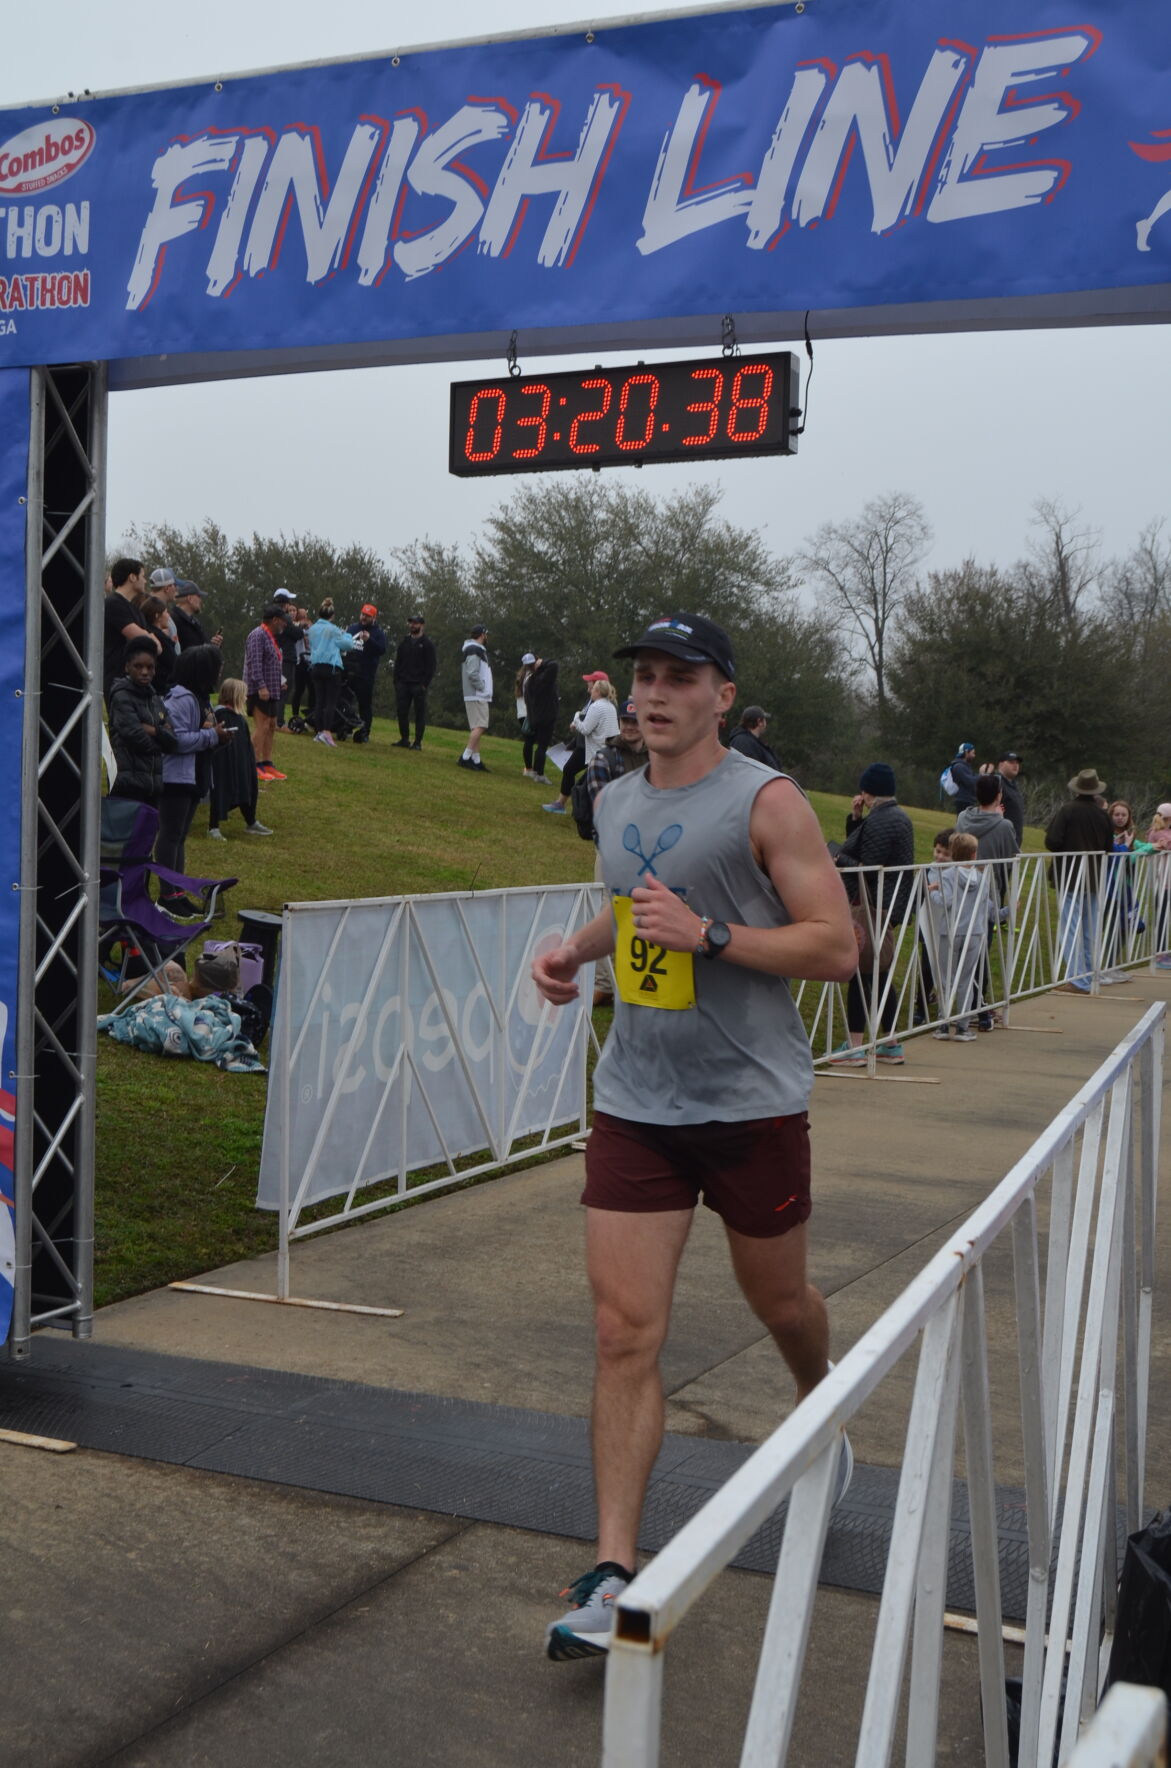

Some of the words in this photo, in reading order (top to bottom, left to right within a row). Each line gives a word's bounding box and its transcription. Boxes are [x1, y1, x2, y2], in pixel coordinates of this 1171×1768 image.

[0, 127, 86, 182] Combos
[125, 90, 627, 312] FINISH
[635, 30, 1095, 256] LINE
[630, 935, 667, 976] 92
